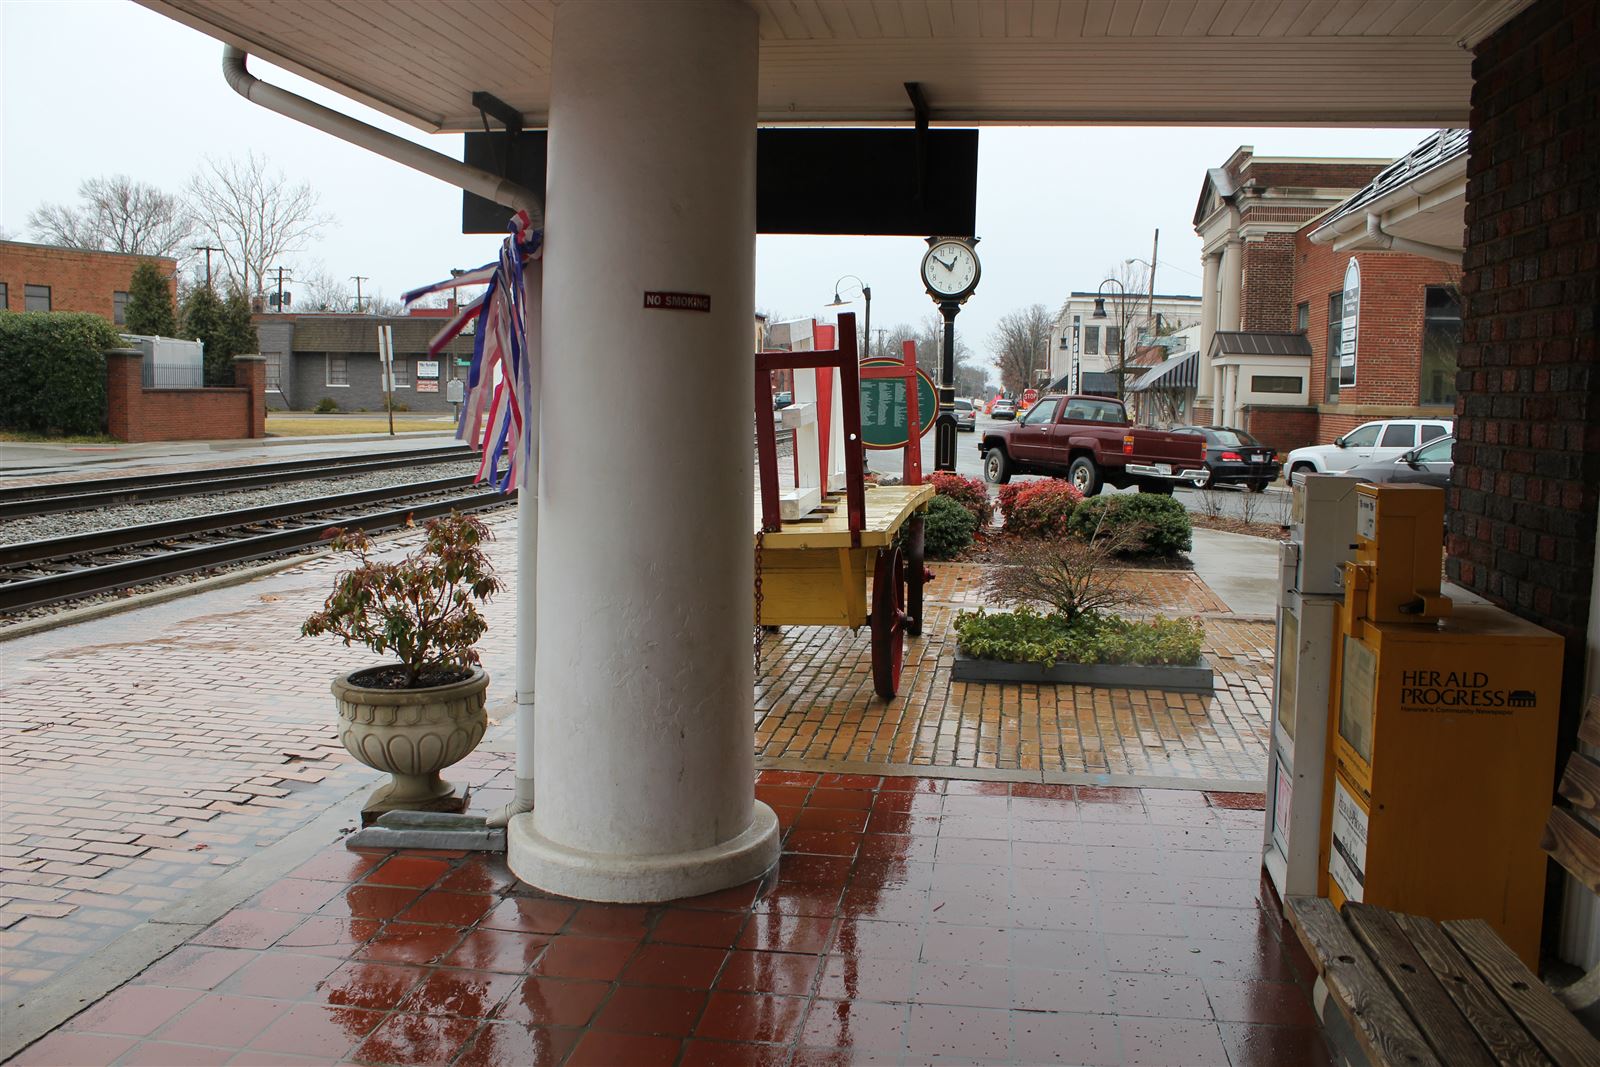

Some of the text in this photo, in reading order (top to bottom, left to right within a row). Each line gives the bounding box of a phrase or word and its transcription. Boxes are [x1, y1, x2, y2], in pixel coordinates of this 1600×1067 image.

[646, 295, 708, 309] NO SMOKING
[1402, 670, 1489, 689] HERALD
[1400, 688, 1505, 707] PROGRESS
[1435, 707, 1474, 716] Community
[1475, 708, 1514, 716] Newspaper
